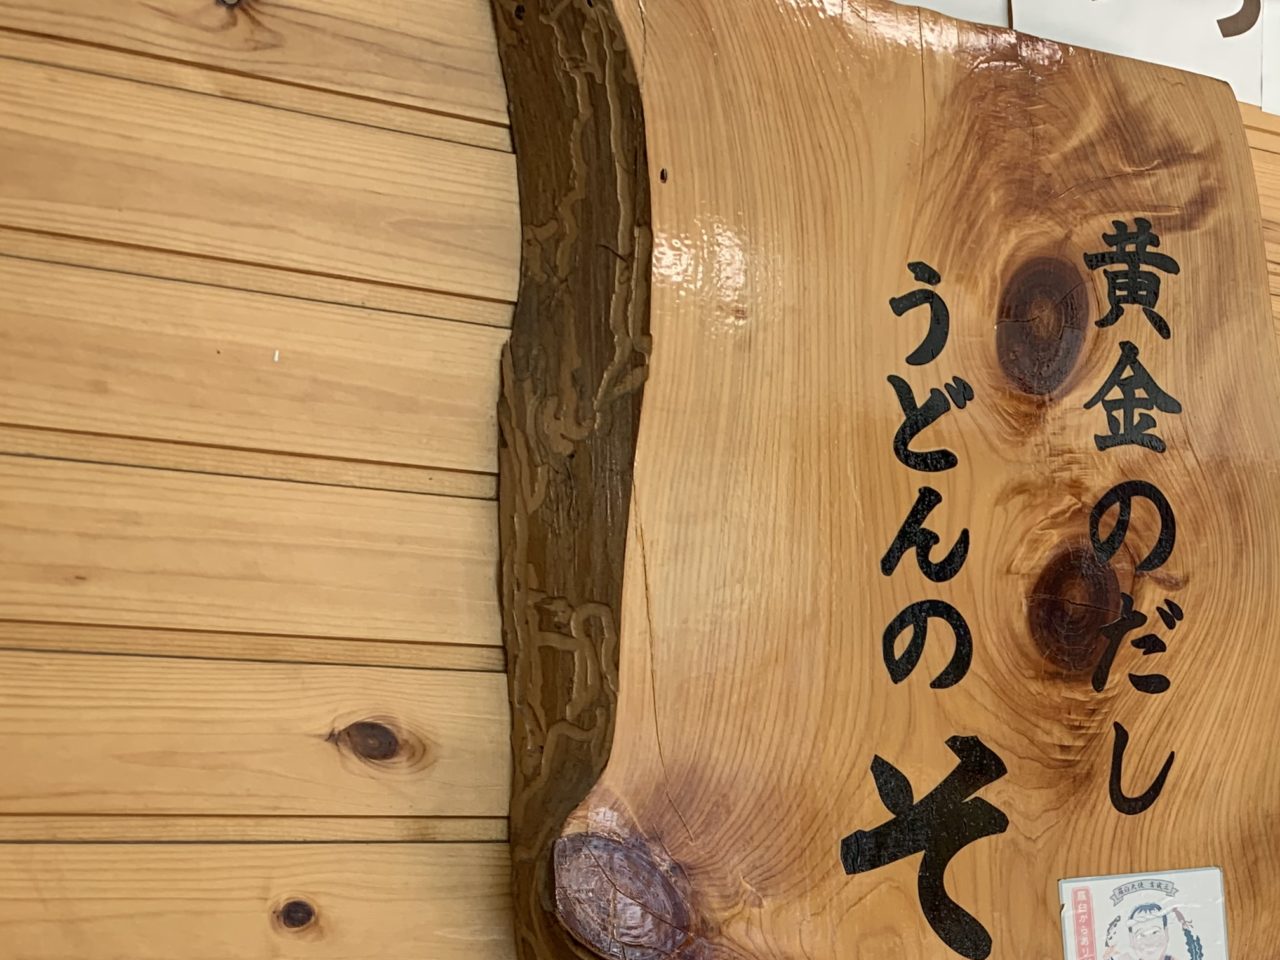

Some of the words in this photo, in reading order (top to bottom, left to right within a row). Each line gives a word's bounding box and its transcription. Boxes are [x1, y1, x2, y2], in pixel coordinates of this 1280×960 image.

[880, 261, 975, 689] うどんの
[1083, 218, 1183, 815] 黄金のだし
